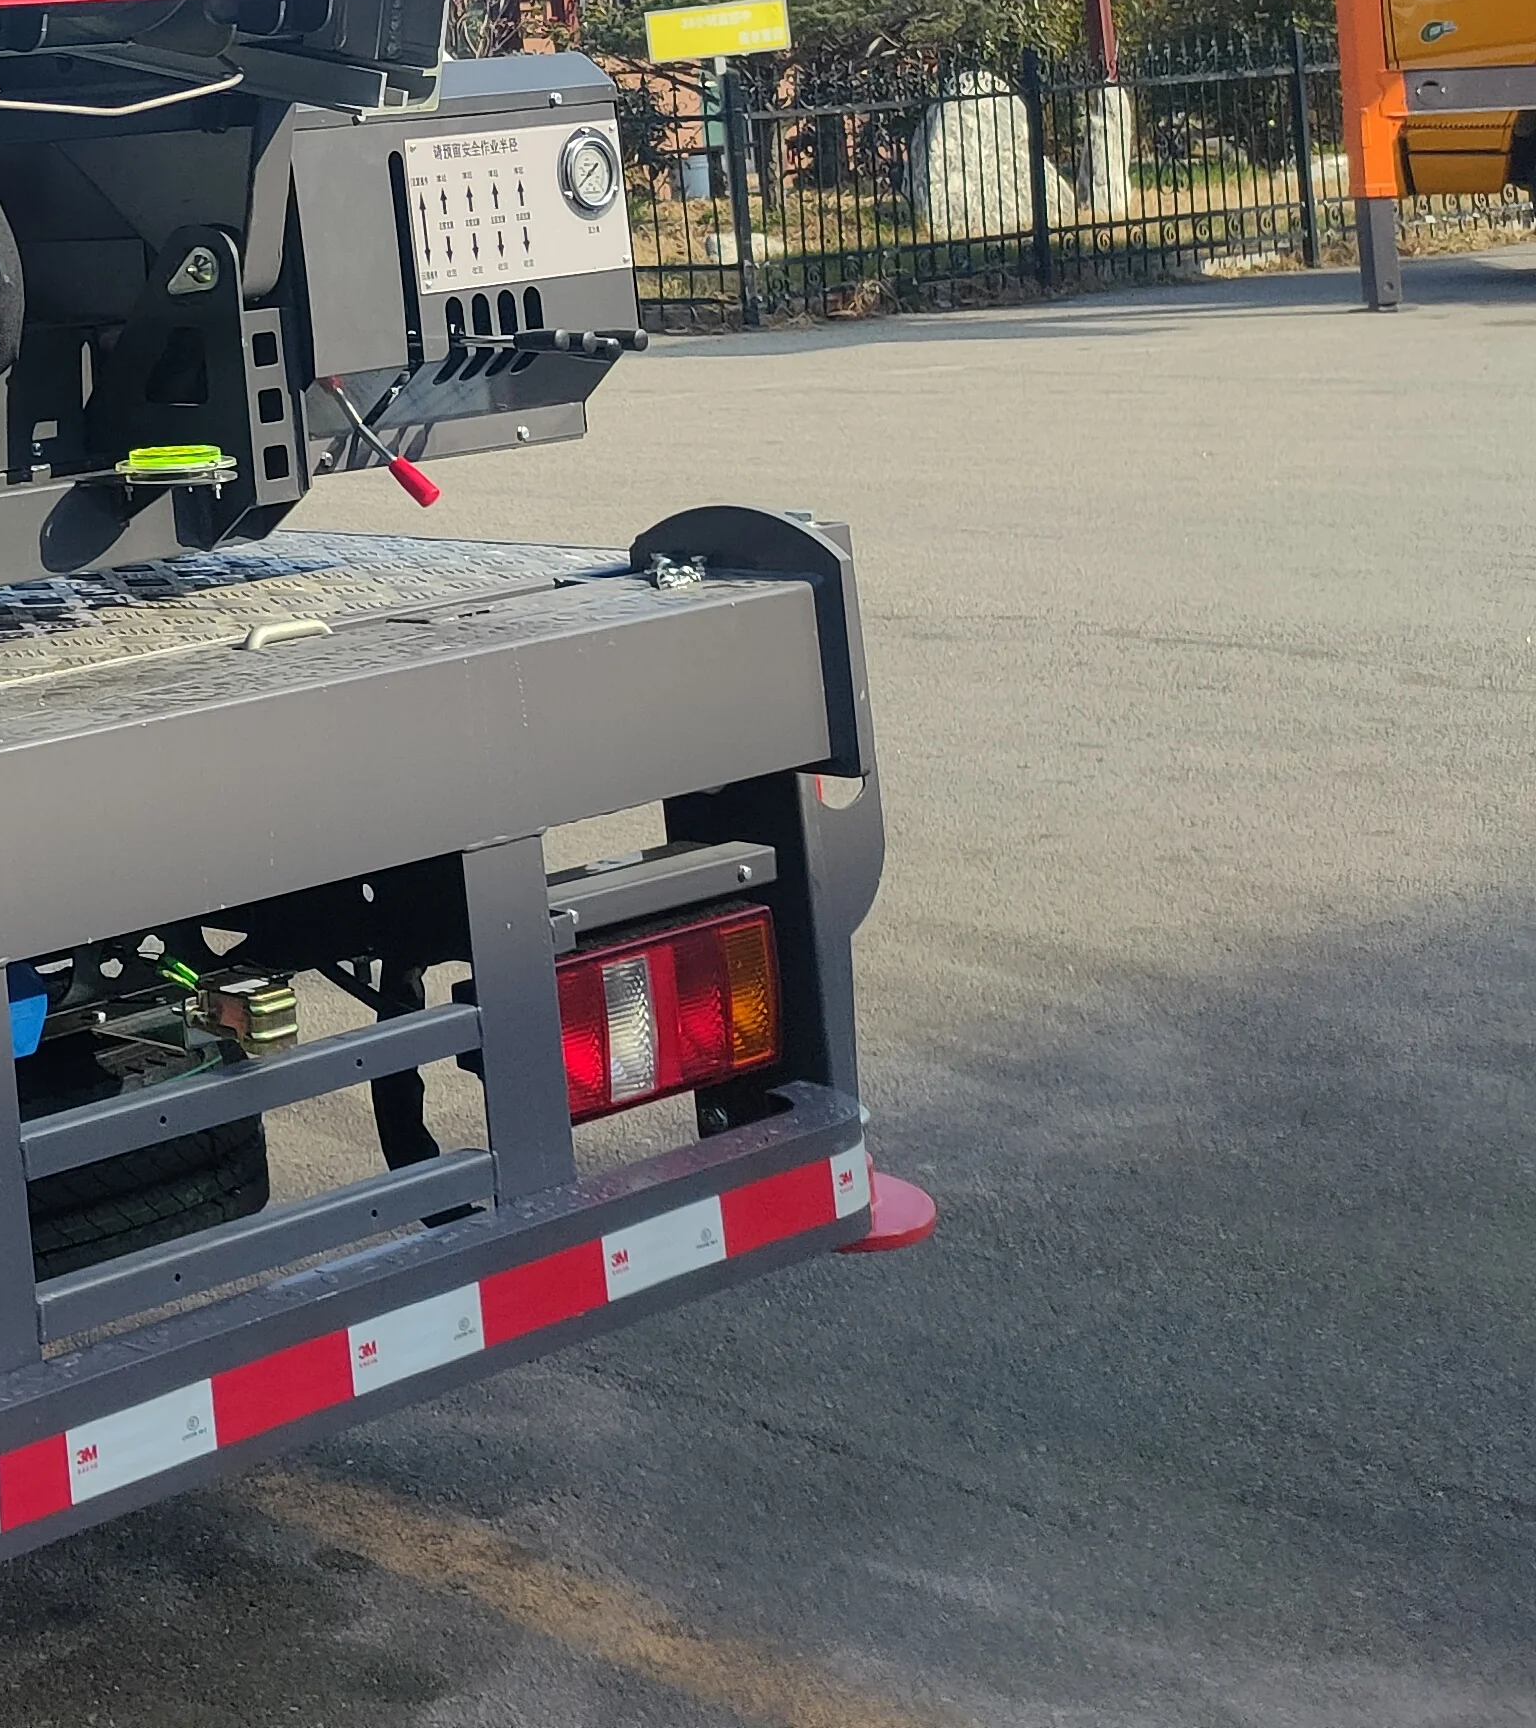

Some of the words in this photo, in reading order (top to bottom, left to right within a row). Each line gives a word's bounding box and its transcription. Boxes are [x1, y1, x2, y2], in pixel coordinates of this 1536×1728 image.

[611, 1249, 629, 1268] 3M
[358, 1340, 377, 1360] 3M
[76, 1443, 98, 1465] 3M
